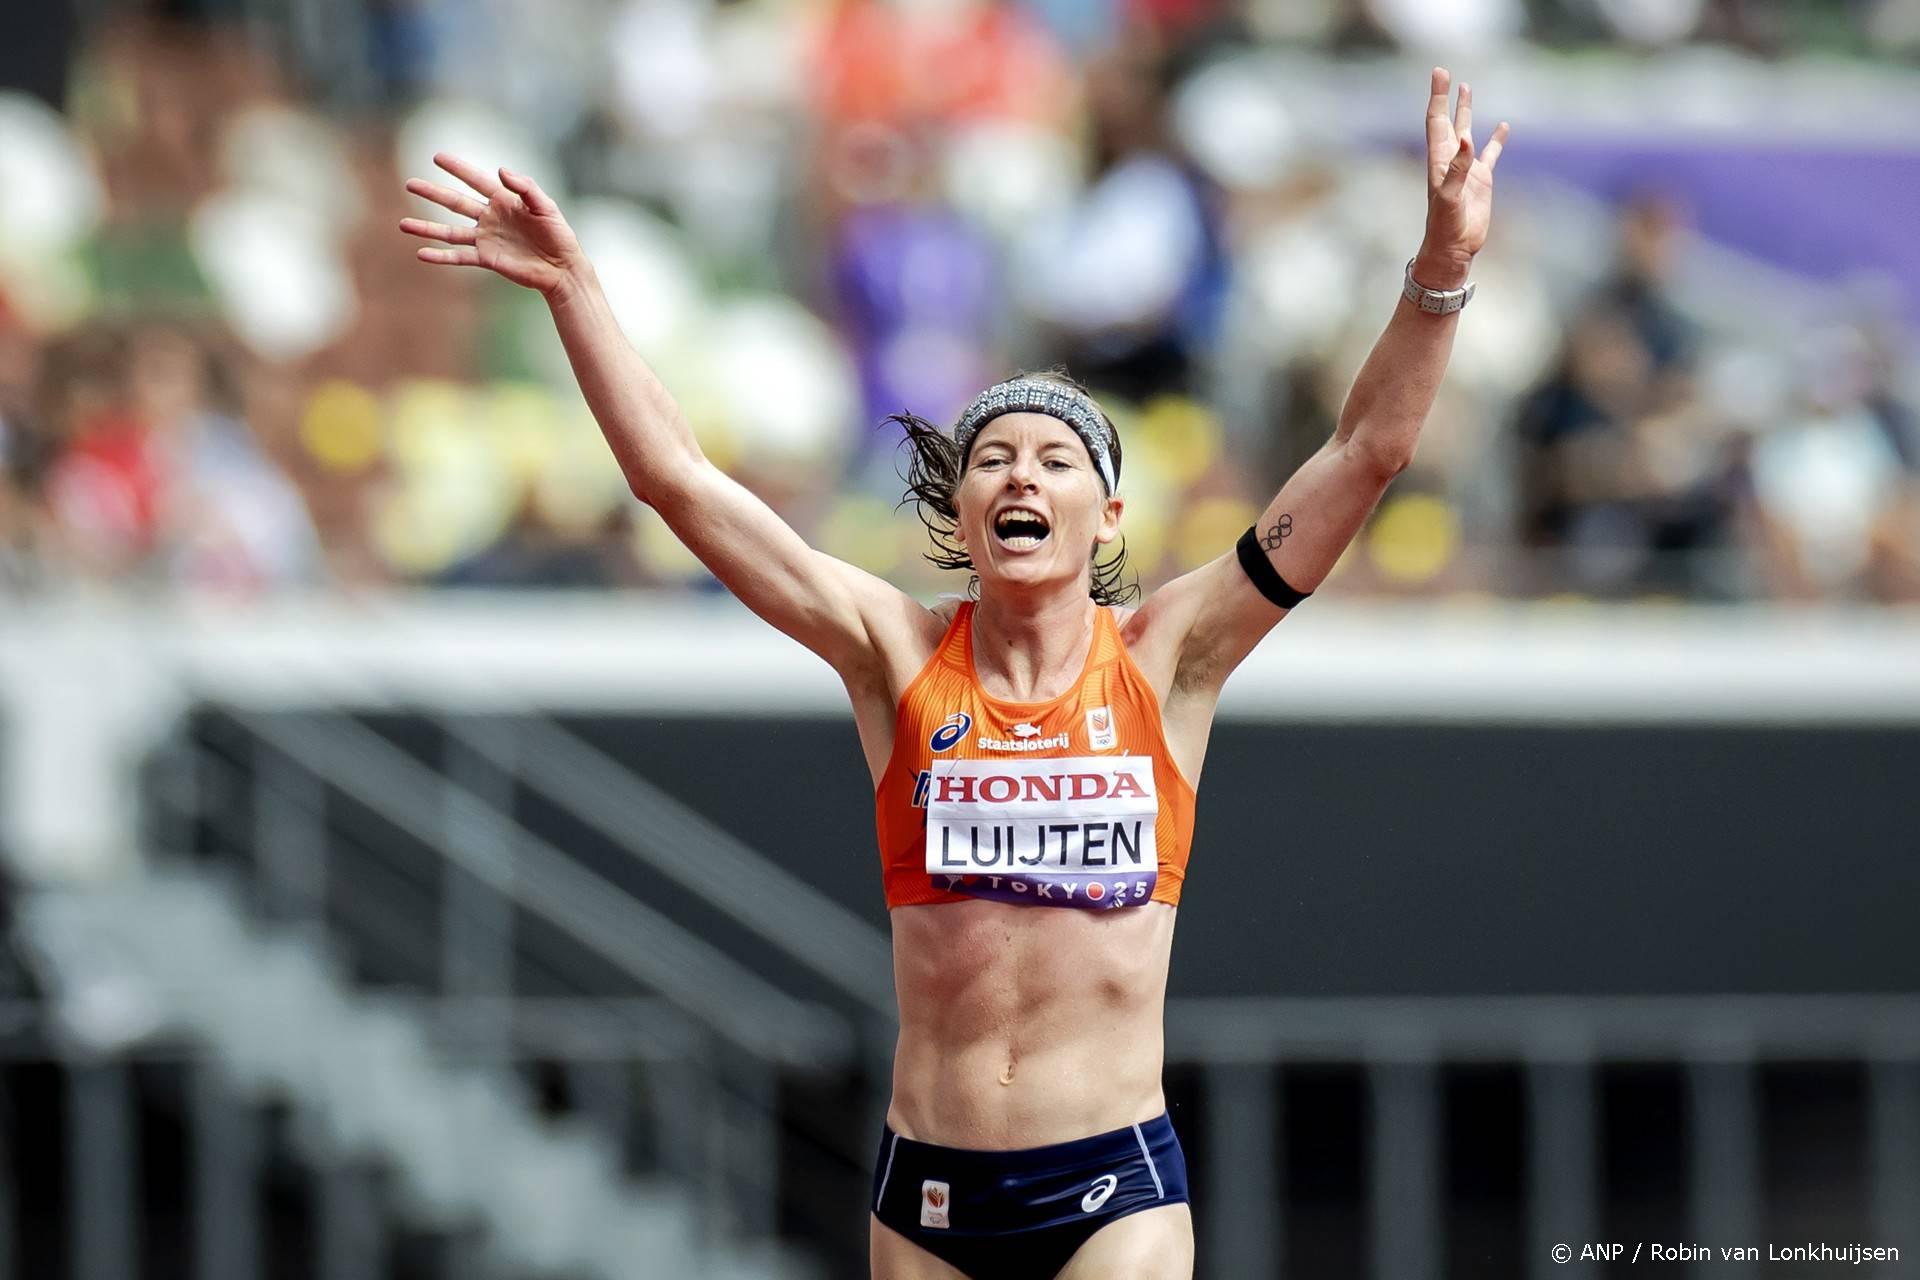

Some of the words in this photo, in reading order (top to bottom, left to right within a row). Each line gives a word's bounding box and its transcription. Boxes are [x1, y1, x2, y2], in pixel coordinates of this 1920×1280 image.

[978, 733, 1069, 751] Staatsloterij
[934, 773, 1150, 802] HONDA
[942, 821, 1142, 866] LUIJTEN
[1113, 881, 1147, 898] 25
